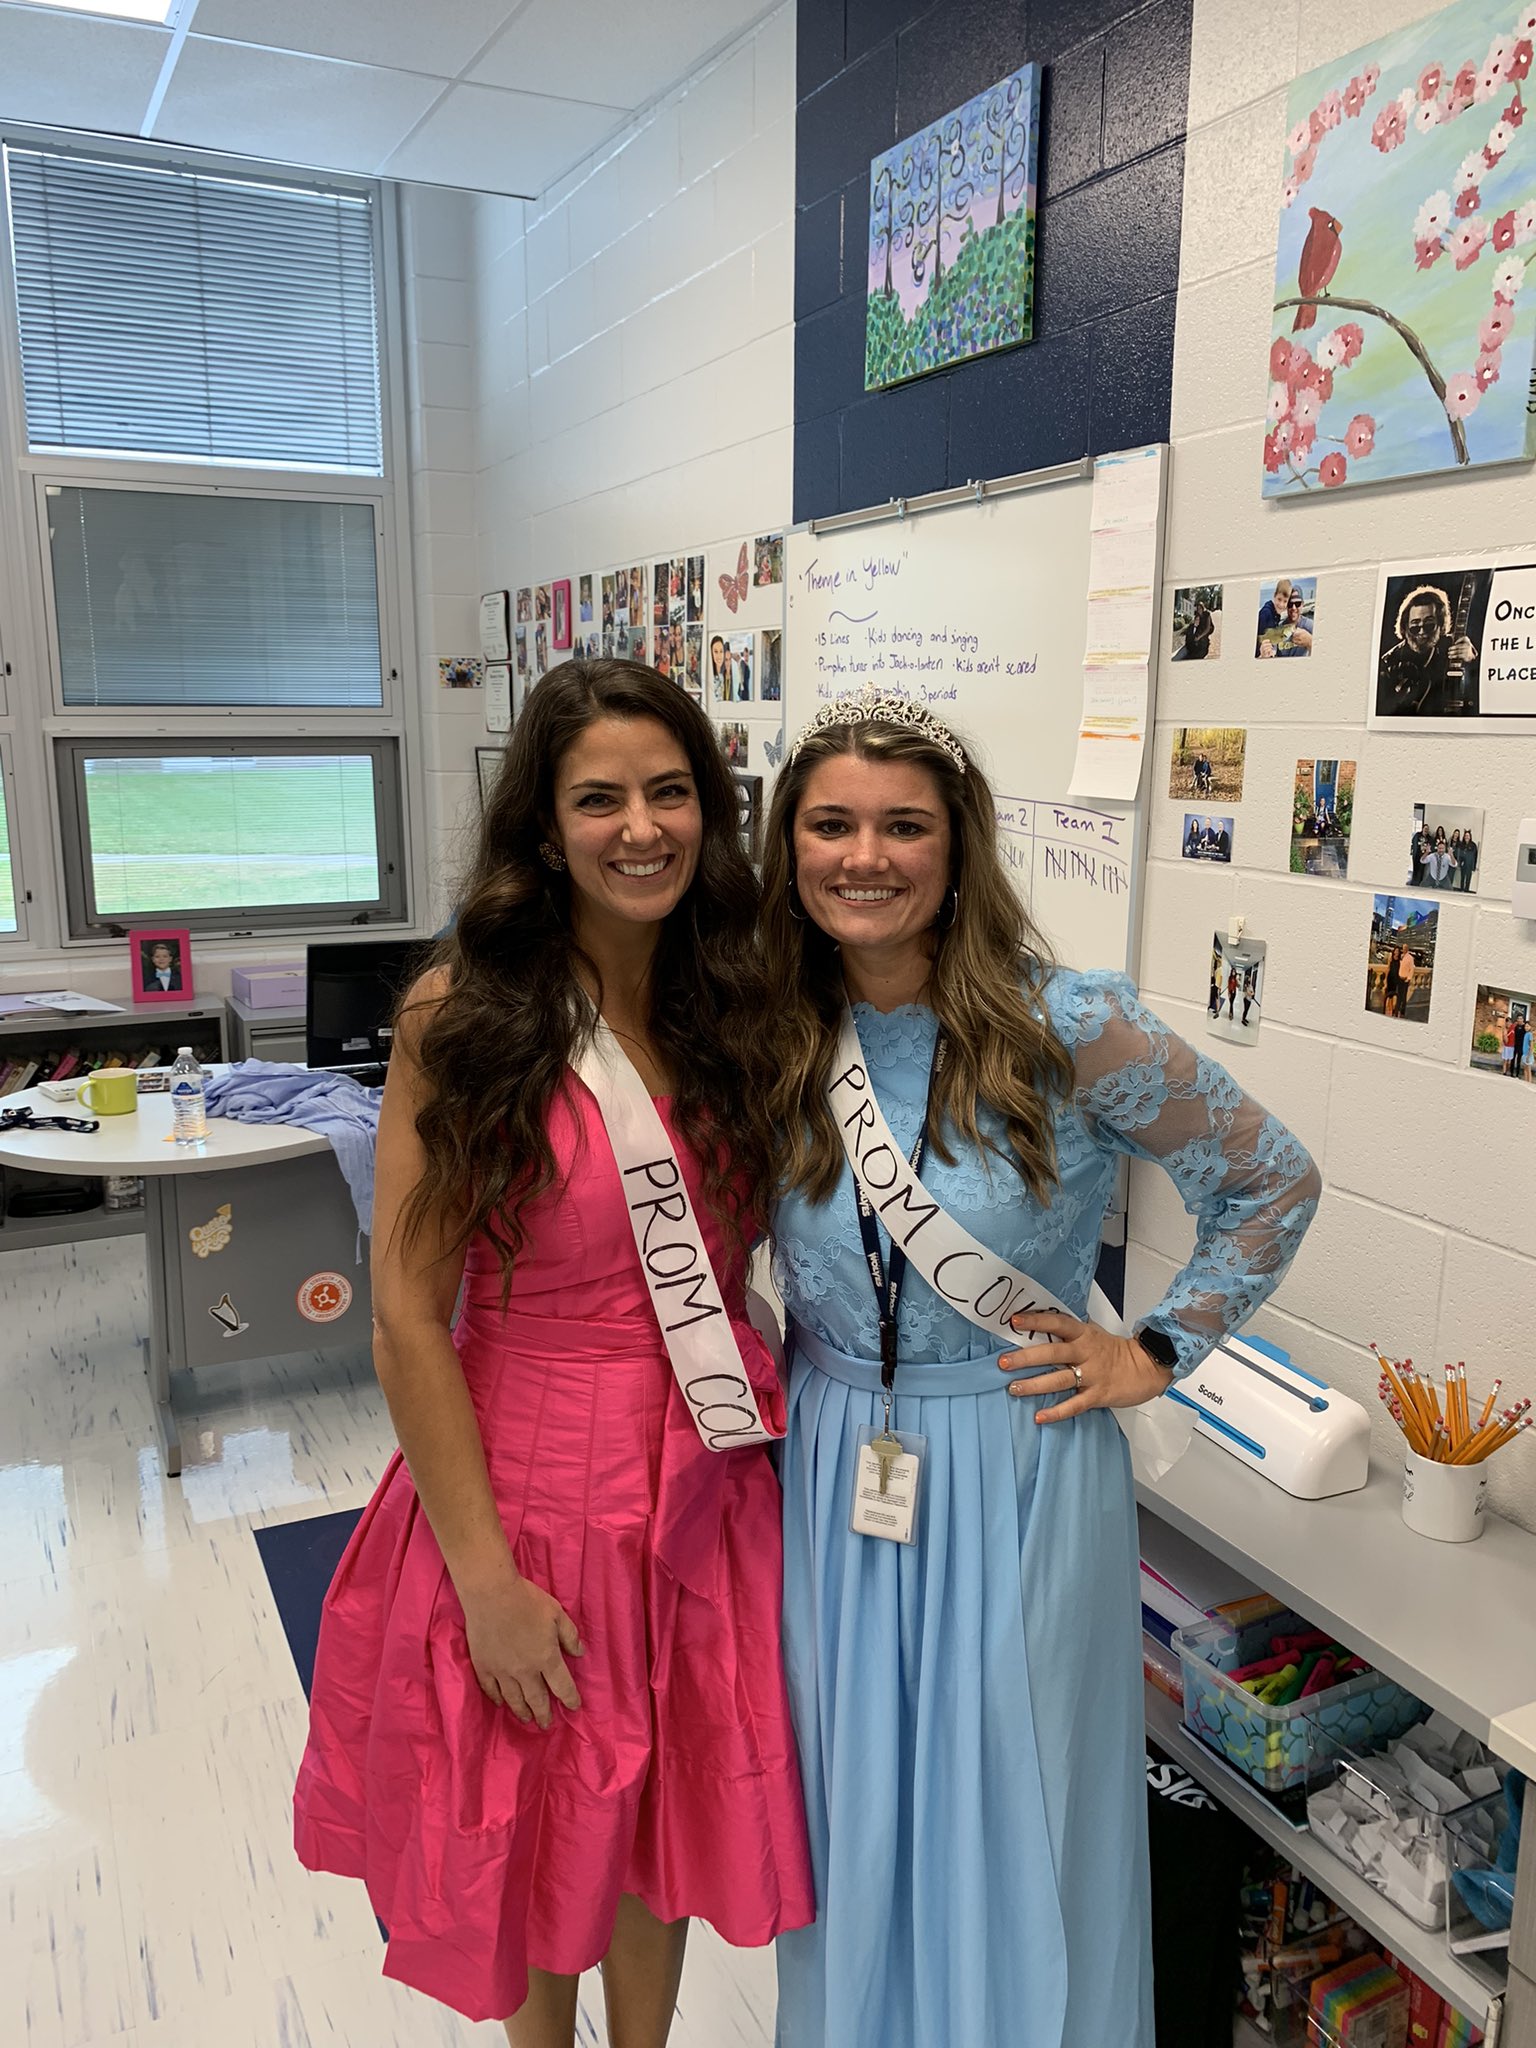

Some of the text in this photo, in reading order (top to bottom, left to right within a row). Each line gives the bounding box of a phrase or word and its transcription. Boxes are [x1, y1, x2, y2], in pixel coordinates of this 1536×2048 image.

[846, 567, 857, 582] in
[892, 626, 923, 647] dancing
[930, 625, 947, 643] and
[951, 629, 979, 653] singing
[1490, 637, 1519, 651] THE
[1005, 653, 1038, 676] scared
[1488, 667, 1536, 681] PLACE
[920, 684, 927, 701] 3
[1018, 808, 1028, 827] 2
[1053, 809, 1095, 832] Team
[828, 1063, 941, 1247] PROM
[623, 1156, 723, 1333] PROM
[1198, 1384, 1224, 1406] Scotch
